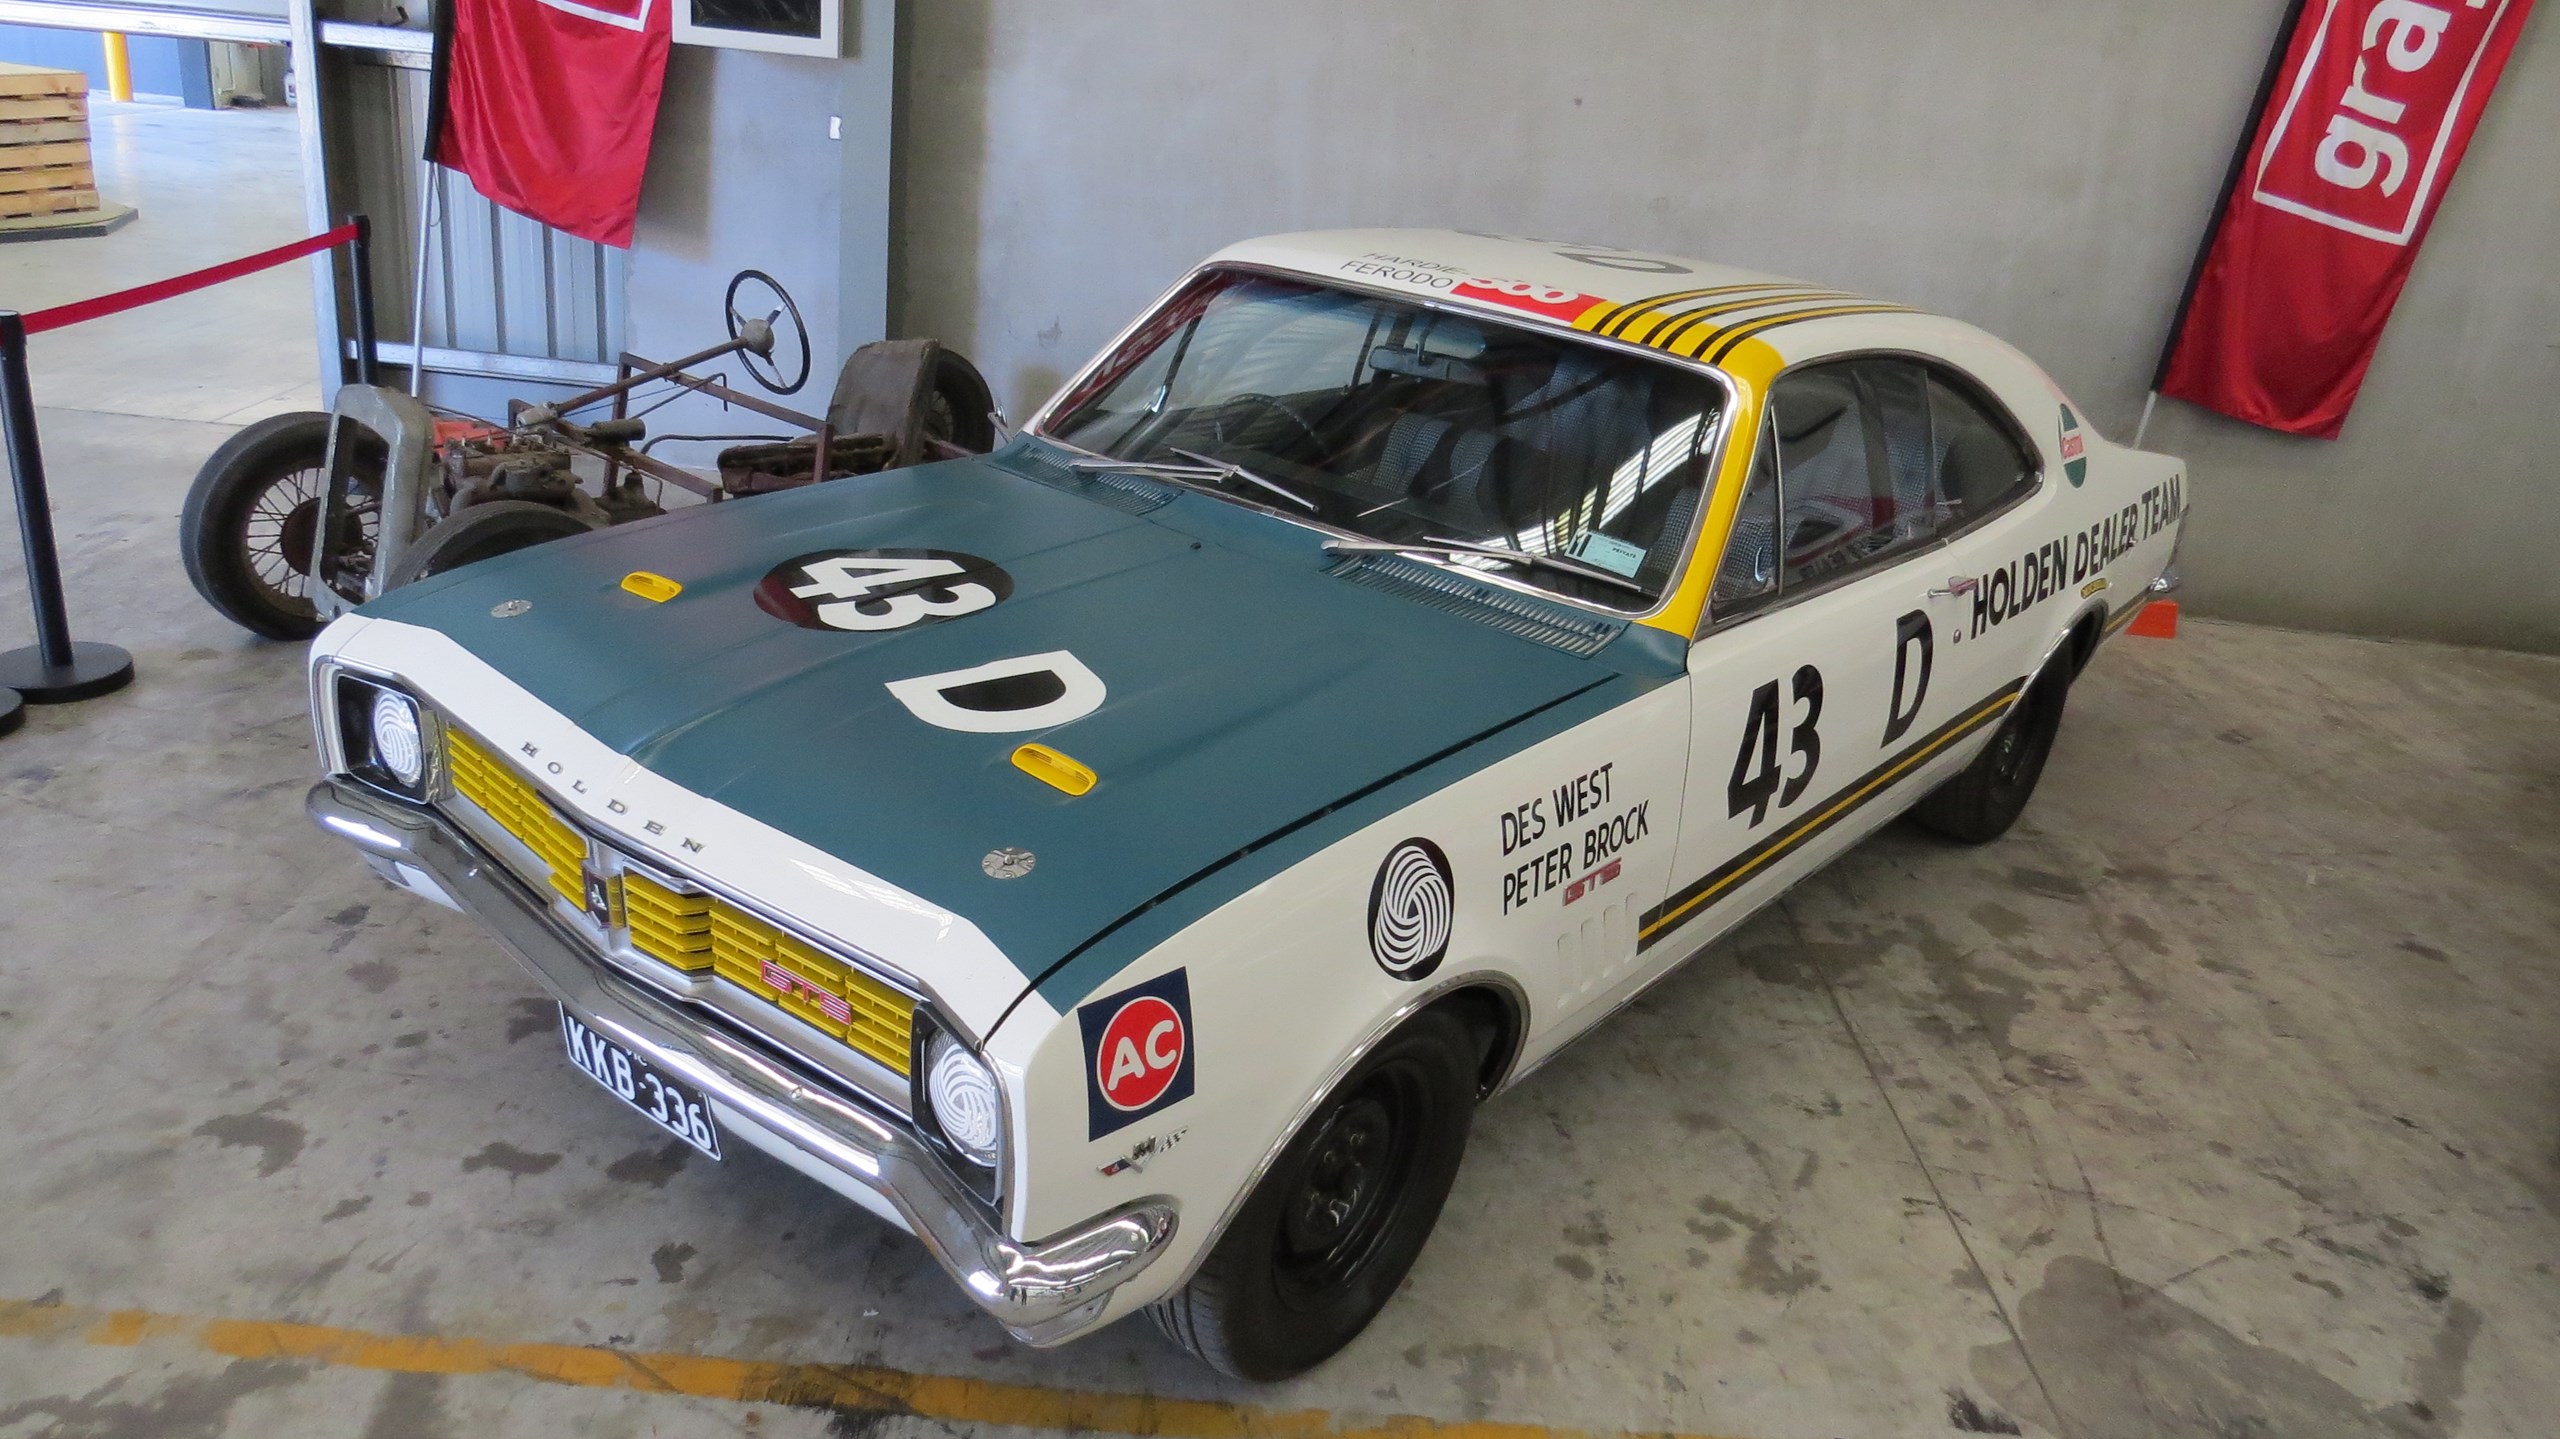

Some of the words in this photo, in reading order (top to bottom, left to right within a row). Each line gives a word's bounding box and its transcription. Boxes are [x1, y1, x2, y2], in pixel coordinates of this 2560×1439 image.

[2314, 0, 2486, 198] gra
[1340, 260, 1454, 289] FERODO
[789, 557, 997, 632] 43
[1970, 535, 2068, 640] HOLDEN
[2072, 503, 2138, 584] DEALER
[2141, 473, 2181, 541] TEAM
[884, 649, 1107, 733] D
[1879, 608, 1934, 749] D
[1727, 663, 1824, 831] 43
[521, 742, 705, 854] HOLDEN
[1501, 797, 1547, 857] DES
[1552, 761, 1613, 828] WEST
[1503, 842, 1573, 917] PETER
[1583, 799, 1650, 871] BROCK
[1562, 857, 1622, 907] GTS
[761, 959, 852, 1025] GTS
[1107, 1019, 1177, 1092] AC
